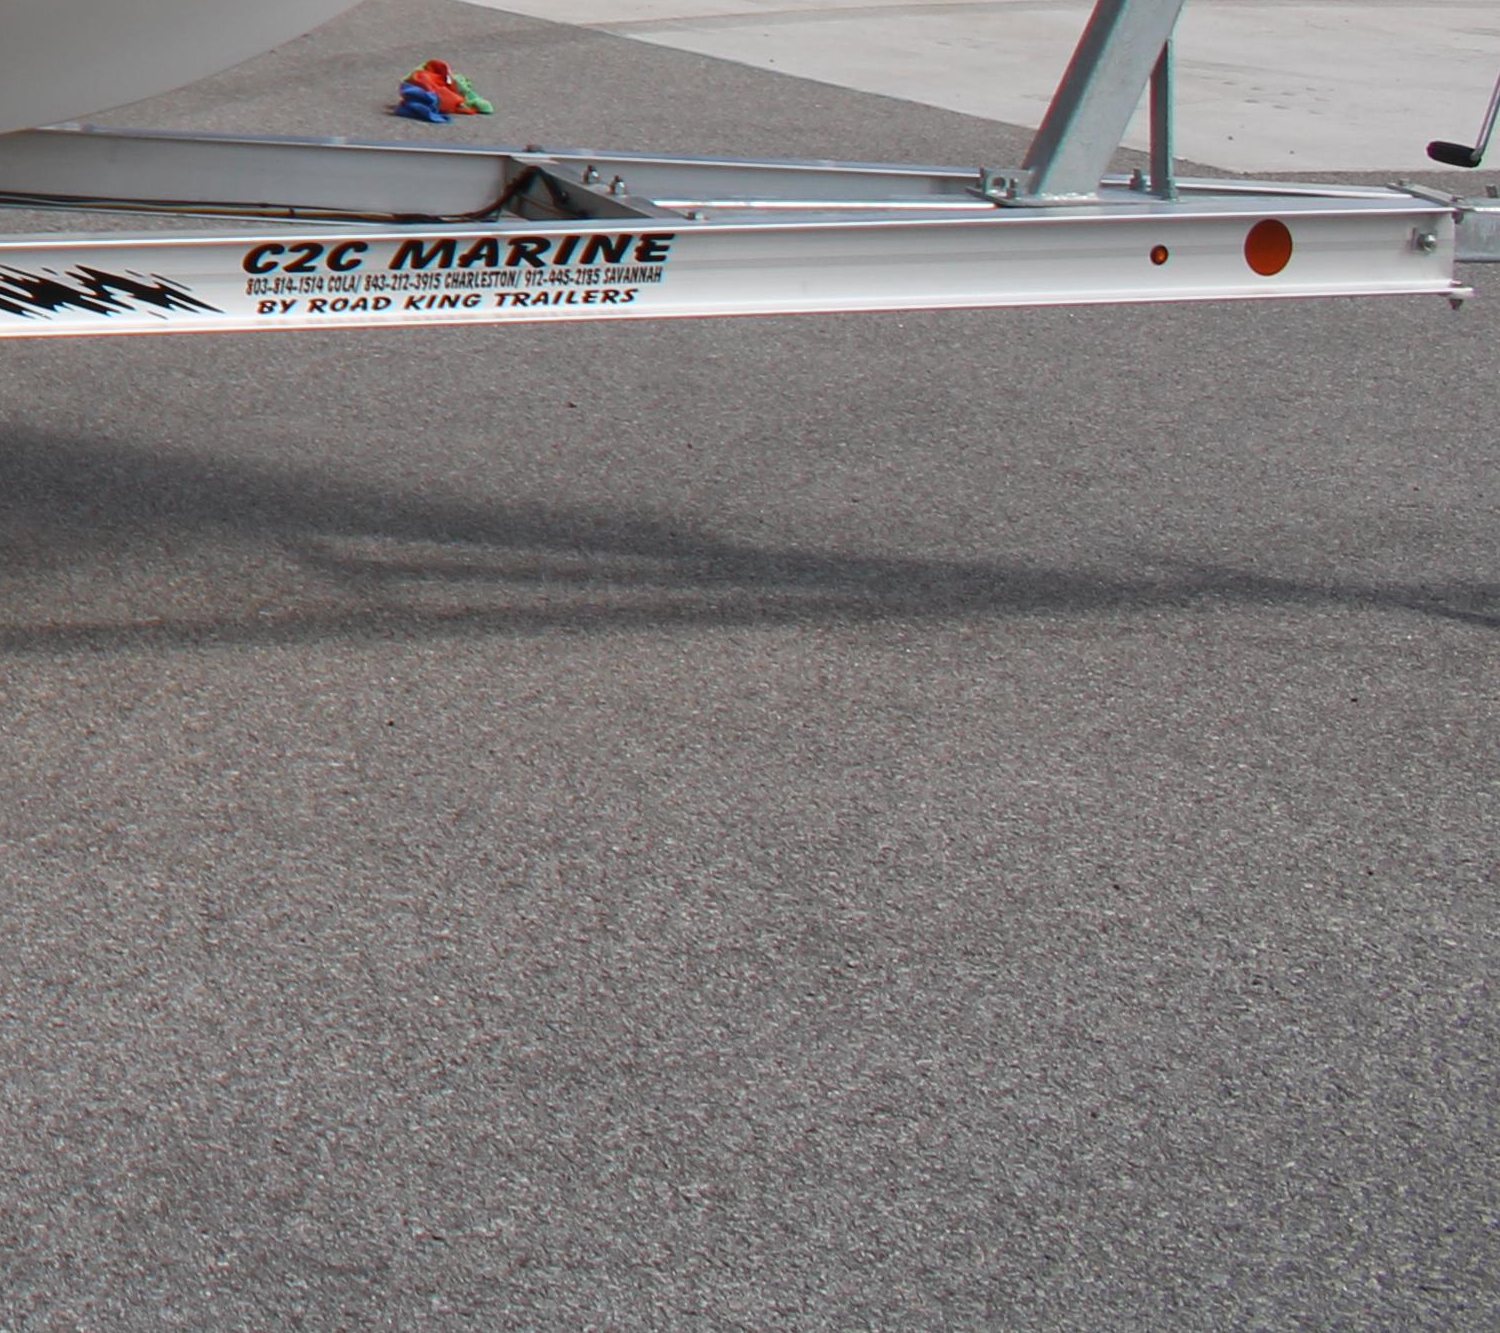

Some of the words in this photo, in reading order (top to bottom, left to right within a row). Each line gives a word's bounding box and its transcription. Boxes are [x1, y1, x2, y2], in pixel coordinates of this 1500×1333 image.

[242, 241, 368, 274] C2C
[389, 234, 675, 270] MARINE
[246, 276, 323, 295] 803-814-1514
[364, 272, 441, 292] 843-212-3915
[524, 268, 600, 287] 912-445-2185
[603, 265, 663, 284] SAVANNAH
[257, 298, 298, 315] BY
[307, 296, 393, 313] ROAD
[403, 293, 482, 310] KING
[494, 288, 639, 307] TRAILERS
